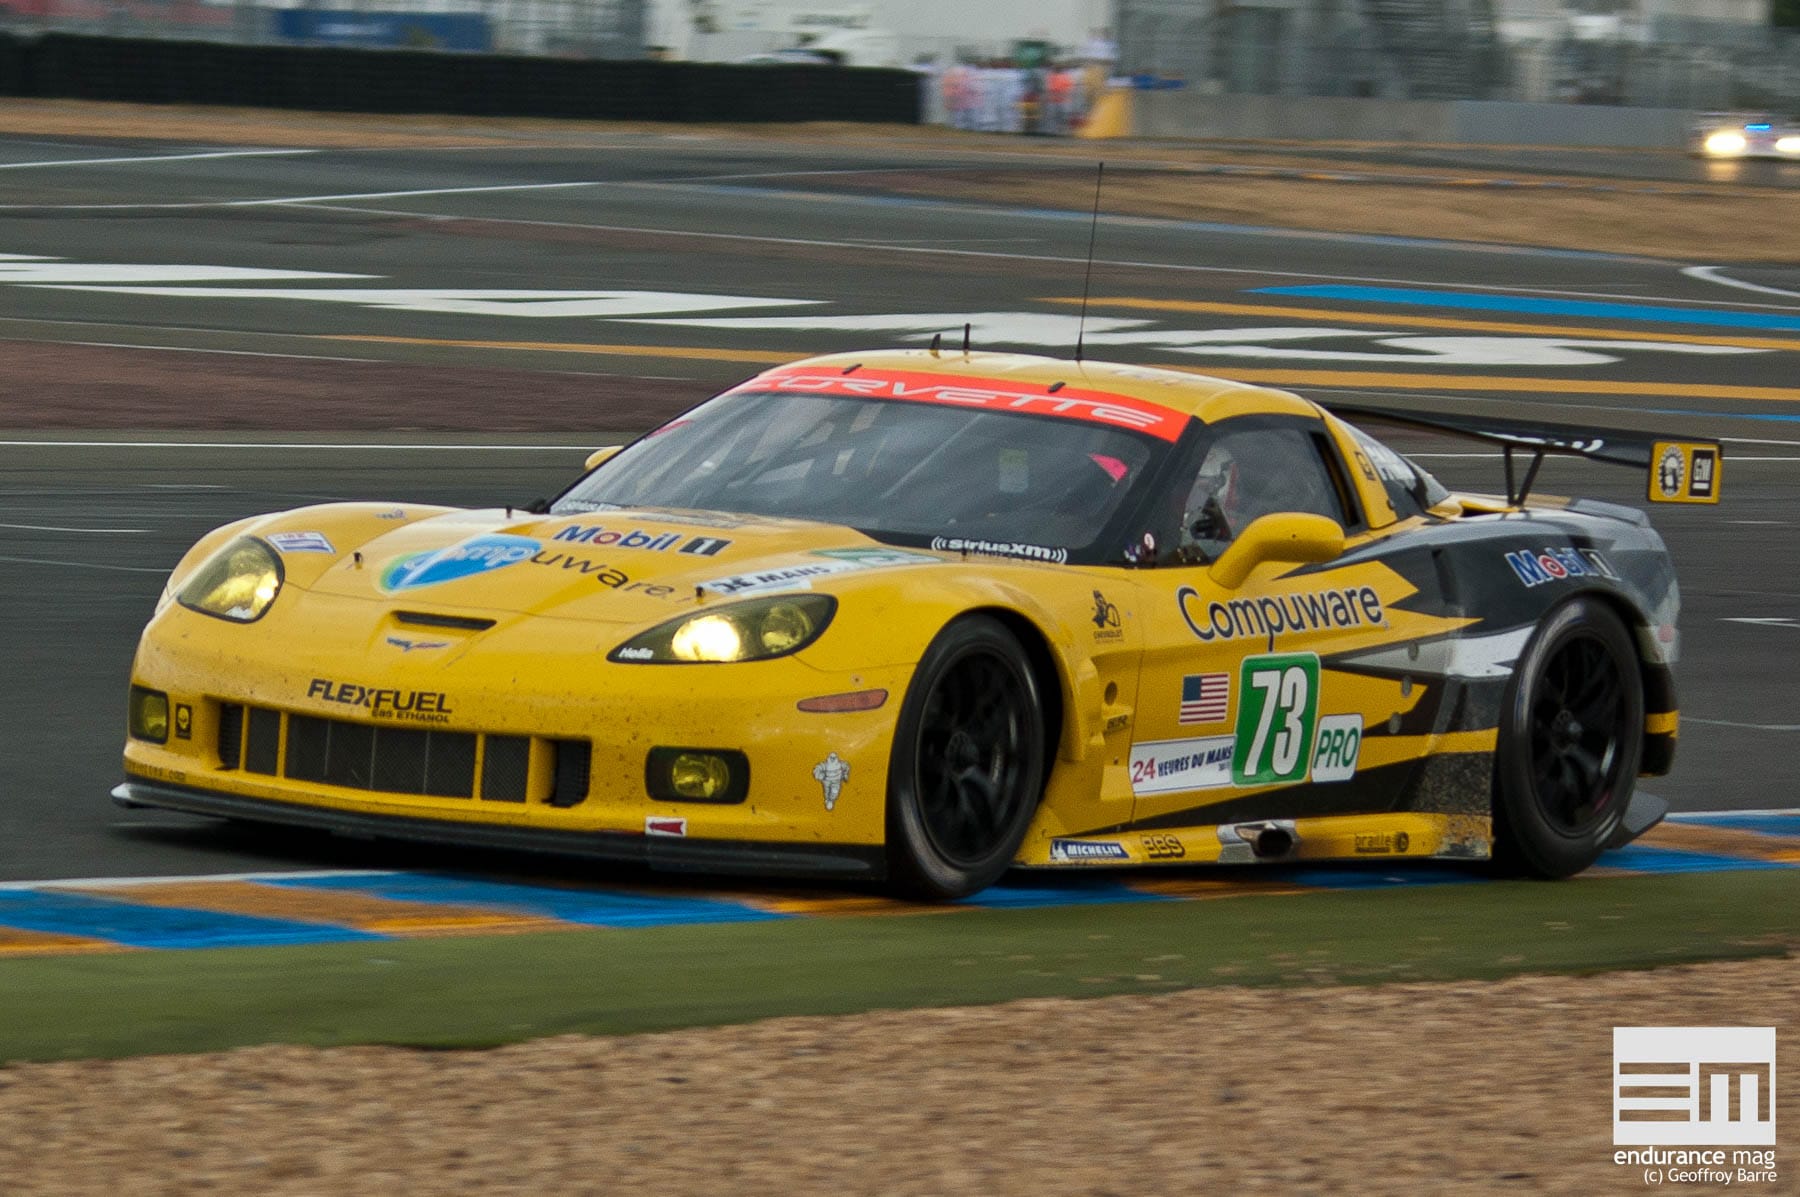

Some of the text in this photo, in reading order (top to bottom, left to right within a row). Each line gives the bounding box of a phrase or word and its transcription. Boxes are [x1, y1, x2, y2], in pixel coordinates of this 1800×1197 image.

[740, 374, 1163, 428] CORVETTE
[553, 525, 683, 551] Mobil
[756, 565, 831, 583] MANS
[1504, 547, 1599, 588] Mobil
[1177, 586, 1383, 653] Compuware
[307, 679, 453, 713] FLEXFUEL
[396, 711, 450, 723] ETHANOL
[1243, 666, 1308, 776] 73
[1132, 757, 1156, 784] 24
[1157, 755, 1191, 777] HEURES
[1191, 752, 1205, 769] DU
[1206, 745, 1233, 765] MANS
[1313, 727, 1358, 769] PRO
[1066, 844, 1122, 857] MICHELIN
[1142, 834, 1185, 858] BBS
